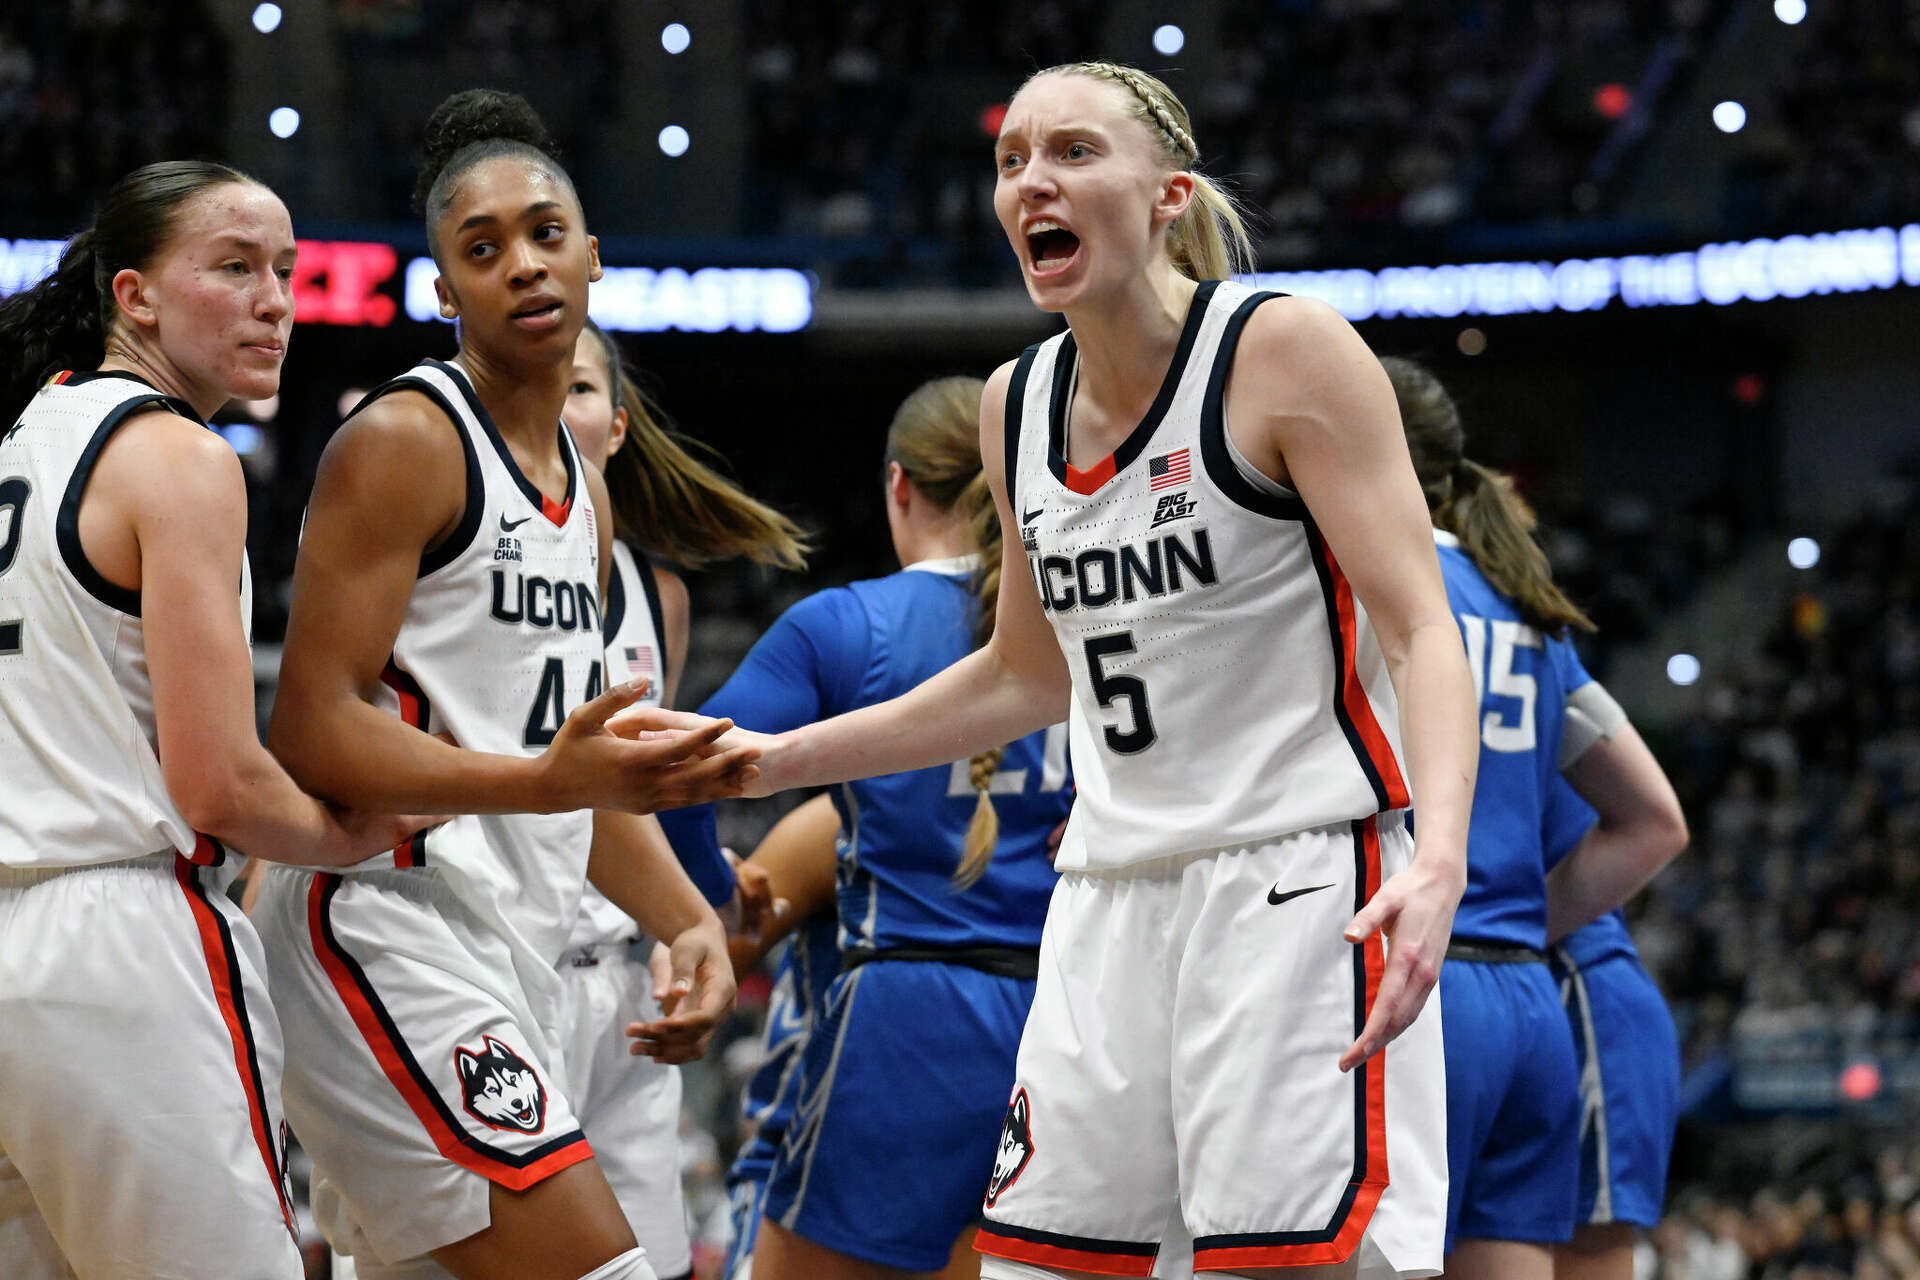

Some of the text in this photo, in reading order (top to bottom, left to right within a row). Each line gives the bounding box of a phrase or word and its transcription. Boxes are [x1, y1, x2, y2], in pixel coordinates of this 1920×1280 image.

[1156, 491, 1188, 510] BIG
[1152, 500, 1198, 522] EAST
[498, 537, 512, 549] BE
[1082, 629, 1159, 757] 5
